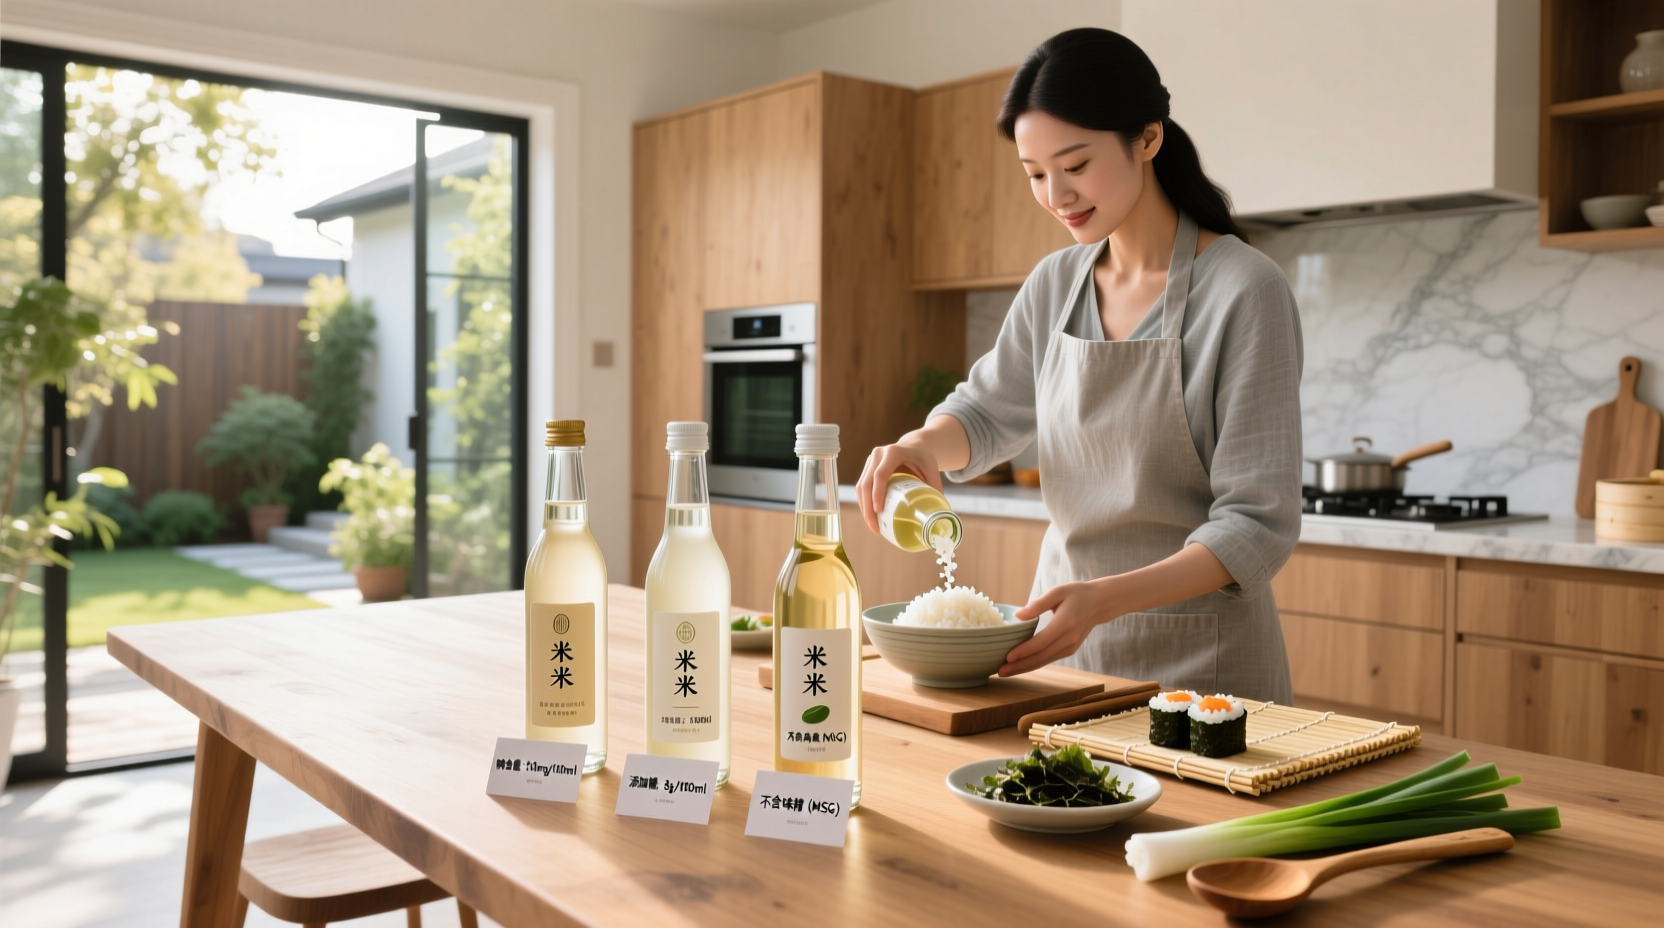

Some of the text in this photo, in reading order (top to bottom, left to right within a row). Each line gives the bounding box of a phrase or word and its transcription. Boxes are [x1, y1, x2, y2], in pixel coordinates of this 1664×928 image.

[550, 641, 574, 689] 米米
[674, 649, 698, 698] 米米
[802, 645, 828, 696] 米米
